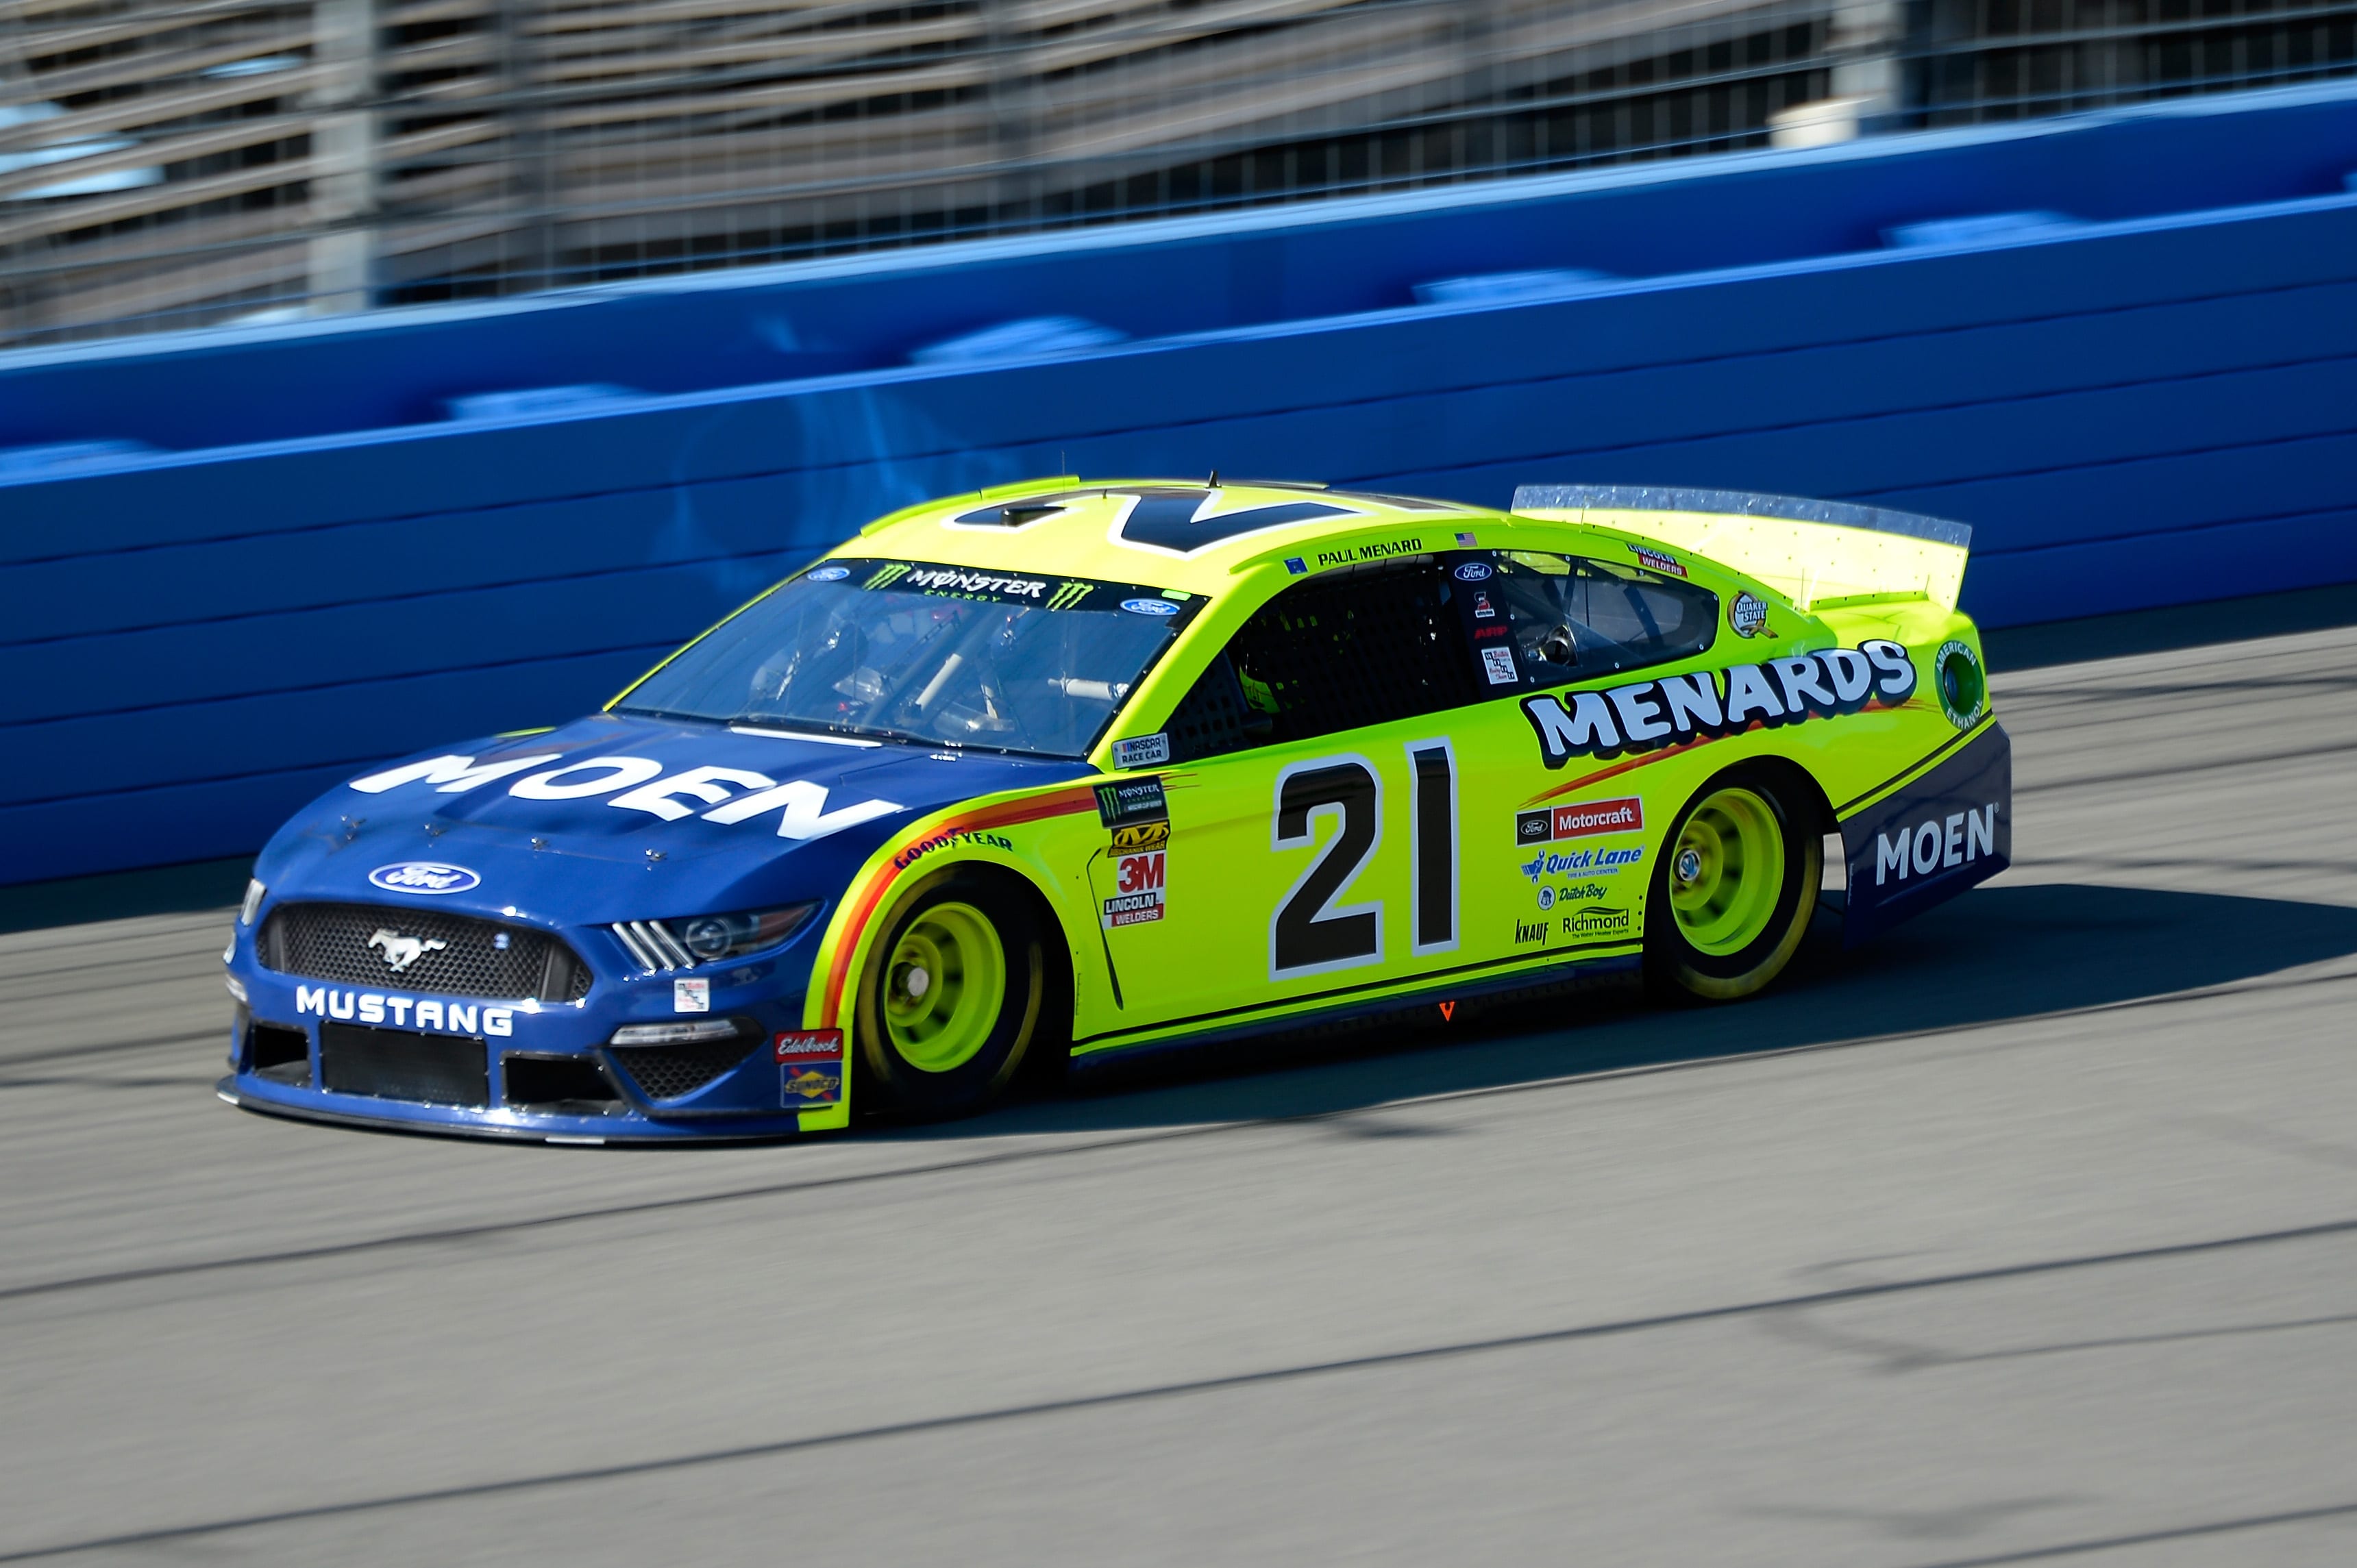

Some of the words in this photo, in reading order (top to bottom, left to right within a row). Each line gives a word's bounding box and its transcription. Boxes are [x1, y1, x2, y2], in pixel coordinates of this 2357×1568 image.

[1317, 549, 1358, 566] PAUL
[1359, 538, 1422, 560] MENARD
[1627, 543, 1675, 563] LINCOLN
[1642, 556, 1683, 575] WELDERS
[924, 589, 1001, 602] ENERGY
[1736, 601, 1768, 613] QUAKER
[1744, 610, 1766, 621] STATE
[1936, 642, 1977, 673] AMERICAN
[1525, 638, 1916, 759] MENARDS
[1947, 700, 1982, 729] ETHANOL
[1129, 737, 1161, 751] NASCAR
[1122, 754, 1144, 764] RACE
[1145, 750, 1162, 759] CAR
[348, 753, 904, 841] MOEN
[1559, 807, 1633, 831] Motorcraft
[1876, 804, 1995, 886] MOEN
[1270, 736, 1458, 981] 21
[1546, 850, 1592, 874] Quick
[1594, 848, 1642, 867] Lane
[1118, 854, 1165, 893] 3M
[1105, 894, 1155, 913] LINCOLN
[1559, 886, 1585, 901] Dutch
[1585, 883, 1607, 900] Boy
[1115, 909, 1159, 925] WELDERS
[1562, 909, 1629, 934] Richmond
[295, 984, 513, 1037] MUSTANG
